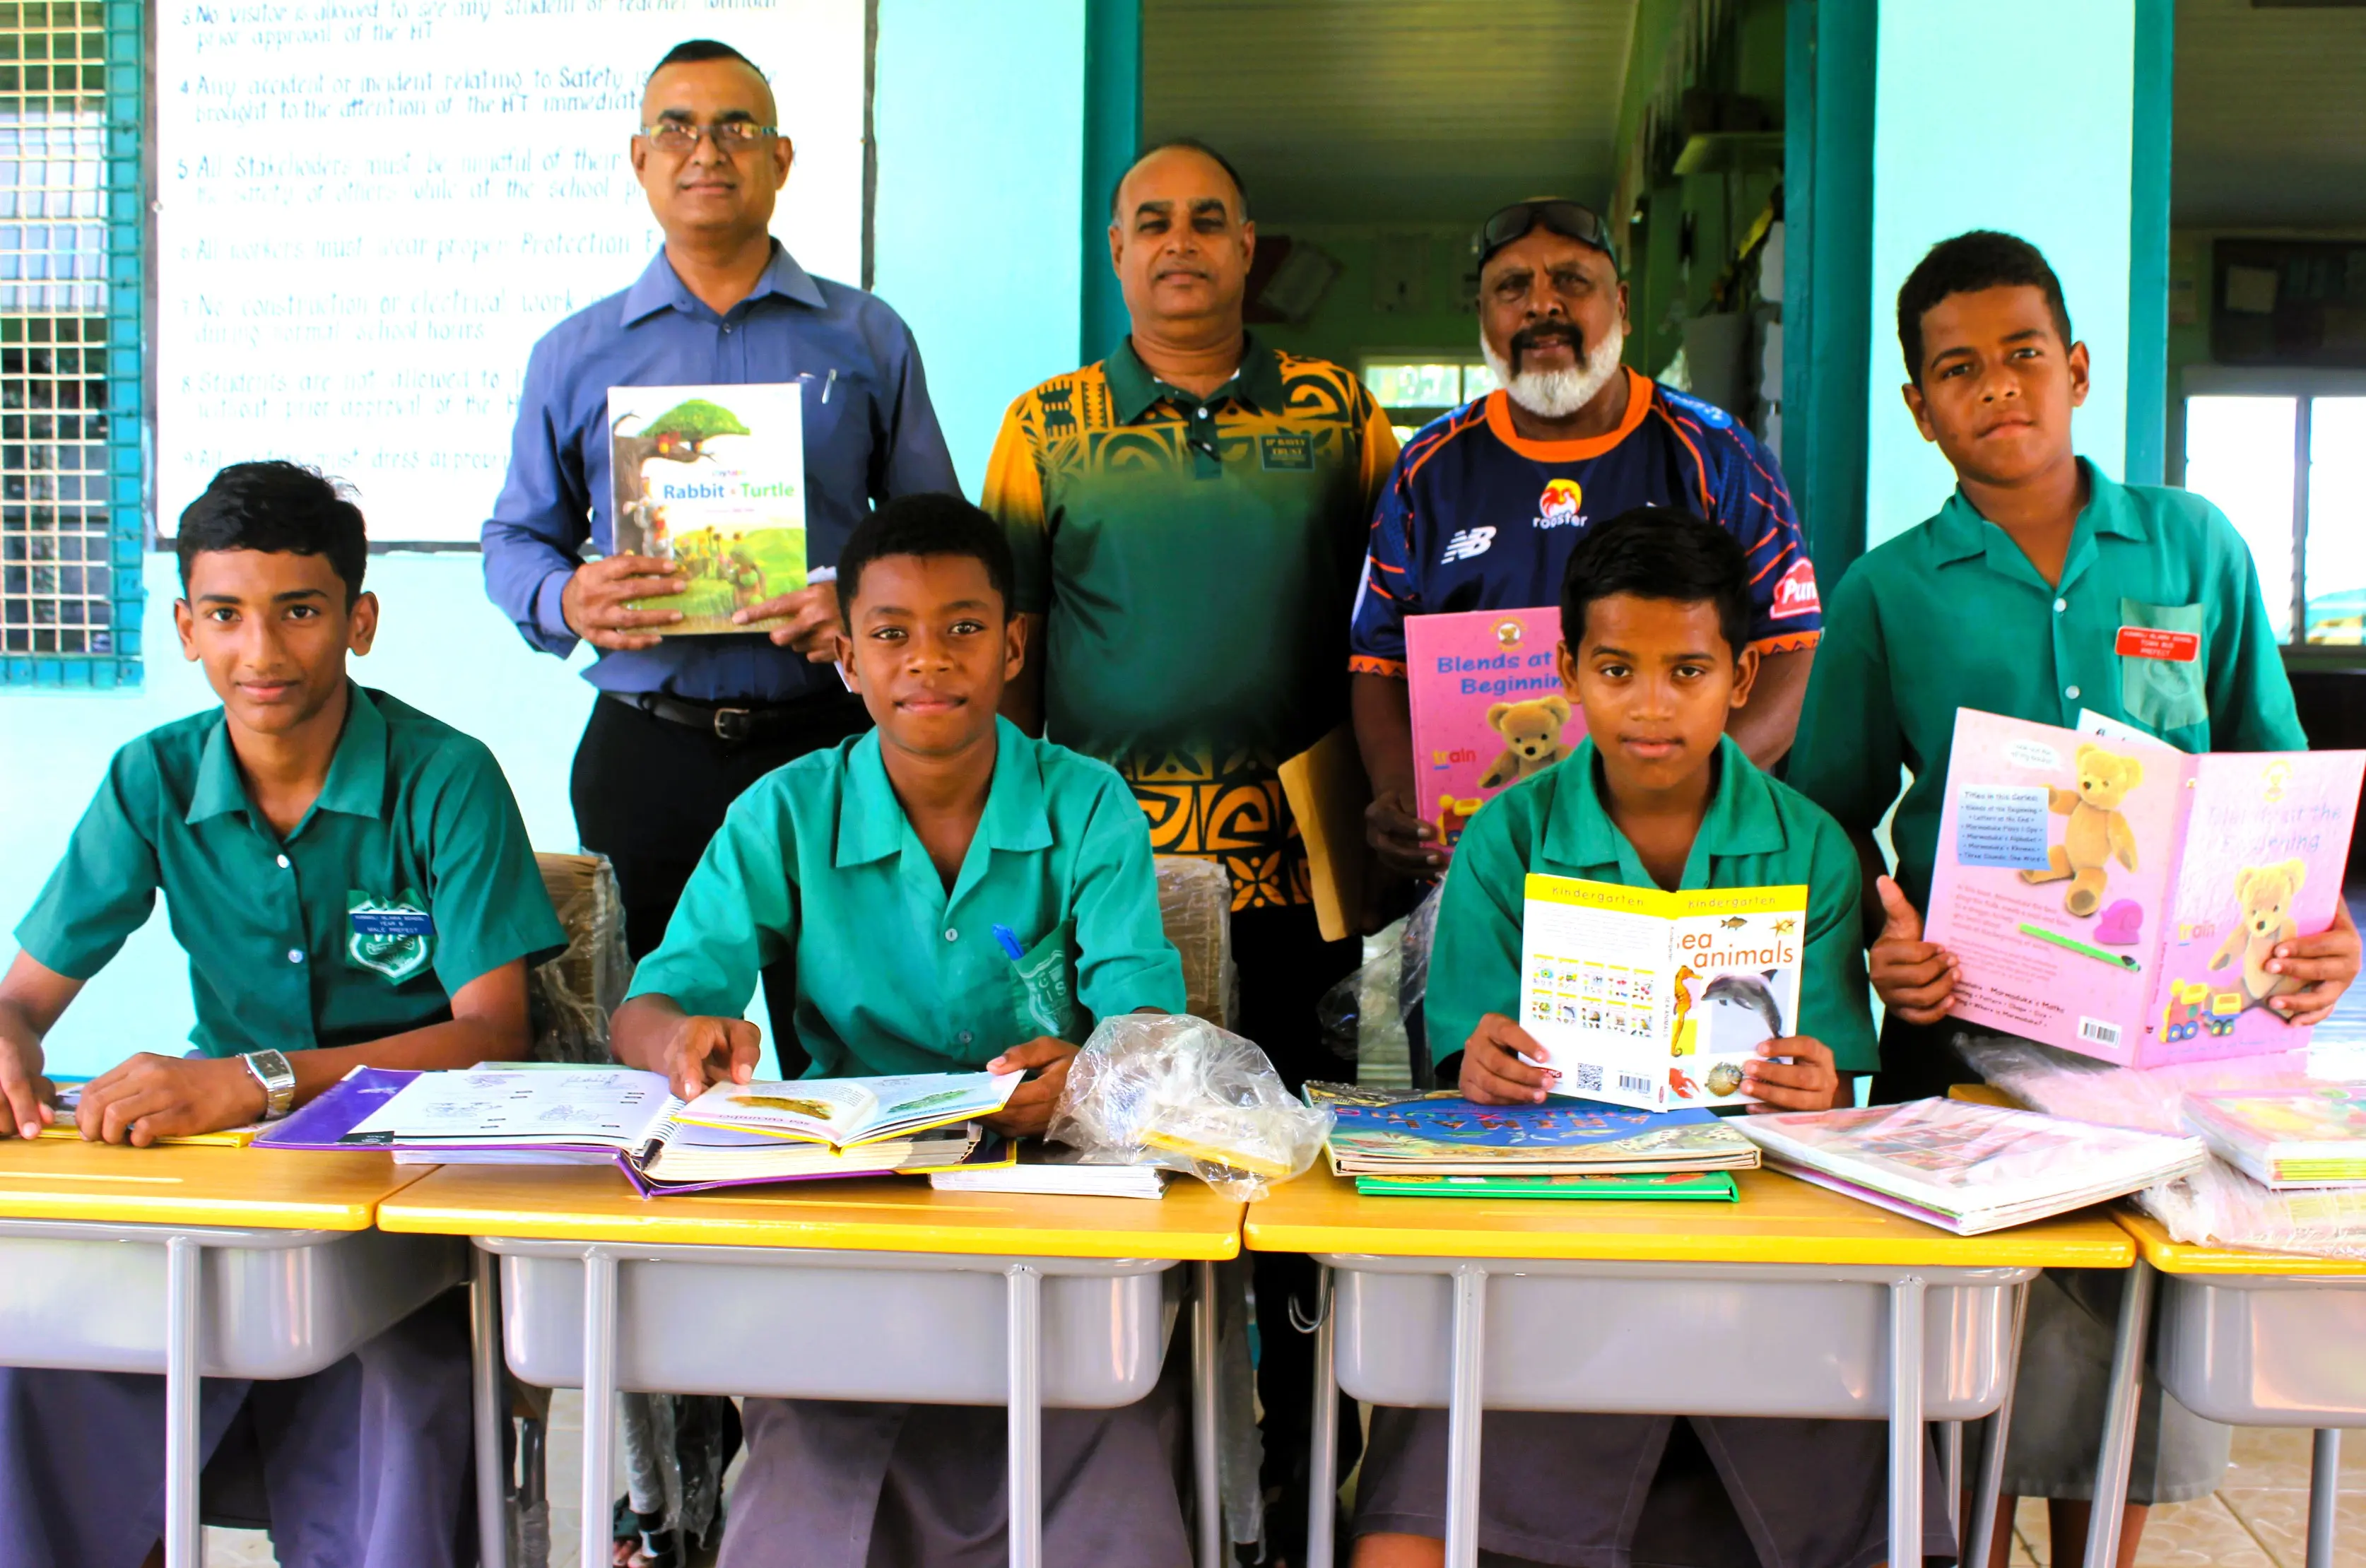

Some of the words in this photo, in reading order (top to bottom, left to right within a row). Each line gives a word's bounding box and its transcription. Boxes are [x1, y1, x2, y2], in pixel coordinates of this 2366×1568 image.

[196, 4, 219, 23] No
[230, 2, 286, 23] visitor
[314, 0, 378, 21] allowed
[391, 1, 408, 18] to
[418, 2, 447, 18] see
[454, 0, 490, 22] any
[252, 25, 330, 52] approval
[344, 22, 363, 43] of
[372, 22, 398, 41] the
[179, 78, 189, 94] 4
[196, 73, 235, 106] Any
[249, 71, 323, 94] accident
[333, 78, 351, 93] or
[360, 71, 432, 93] incident
[445, 66, 523, 96] relating
[534, 69, 552, 88] to
[558, 64, 623, 93] Safety
[196, 100, 266, 127] brought
[281, 100, 298, 119] to
[304, 100, 331, 119] the
[340, 97, 425, 118] attention
[435, 97, 452, 114] of
[466, 95, 495, 113] the
[177, 157, 188, 179] 5
[196, 154, 221, 178] All
[365, 151, 411, 176] must
[427, 149, 447, 174] be
[461, 147, 531, 173] mindful
[542, 146, 563, 172] of
[574, 148, 621, 172] their
[306, 184, 324, 204] of
[335, 180, 397, 204] others
[412, 177, 457, 201] while
[469, 177, 490, 199] at
[505, 178, 534, 199] the
[548, 175, 609, 200] school
[196, 236, 218, 261] All
[230, 237, 303, 260] workers
[316, 236, 362, 259] must
[377, 237, 428, 259] wear
[437, 237, 506, 264] proper
[521, 230, 630, 256] Protection
[199, 293, 223, 318] No
[241, 291, 367, 318] construction
[379, 295, 401, 315] or
[411, 285, 506, 315] electrical
[522, 286, 574, 314] work
[194, 322, 260, 352] during
[273, 321, 340, 343] normal
[355, 319, 418, 343] school
[428, 320, 485, 341] hours
[198, 370, 286, 394] Students
[300, 373, 331, 392] are
[343, 369, 375, 390] not
[391, 367, 469, 389] allowed
[481, 370, 500, 389] to
[198, 394, 268, 418] without
[341, 393, 421, 421] approval
[435, 395, 453, 415] of
[466, 394, 490, 415] the
[371, 445, 420, 468] dress
[664, 483, 725, 499] Rabbit
[740, 482, 795, 497] Turtle
[1532, 512, 1589, 529] rooster
[1782, 577, 1818, 604] Pun
[1437, 654, 1520, 673] Blends
[1527, 651, 1553, 666] at
[1461, 673, 1564, 697] Beginnin
[1432, 748, 1477, 765] train
[1552, 885, 1644, 907] Kindergarten
[1688, 896, 1776, 909] Kindergarten
[2178, 921, 2215, 941] train
[1693, 941, 1794, 968] animals
[719, 1114, 783, 1123] cucumber
[1387, 1114, 1650, 1130] ANIMAL
